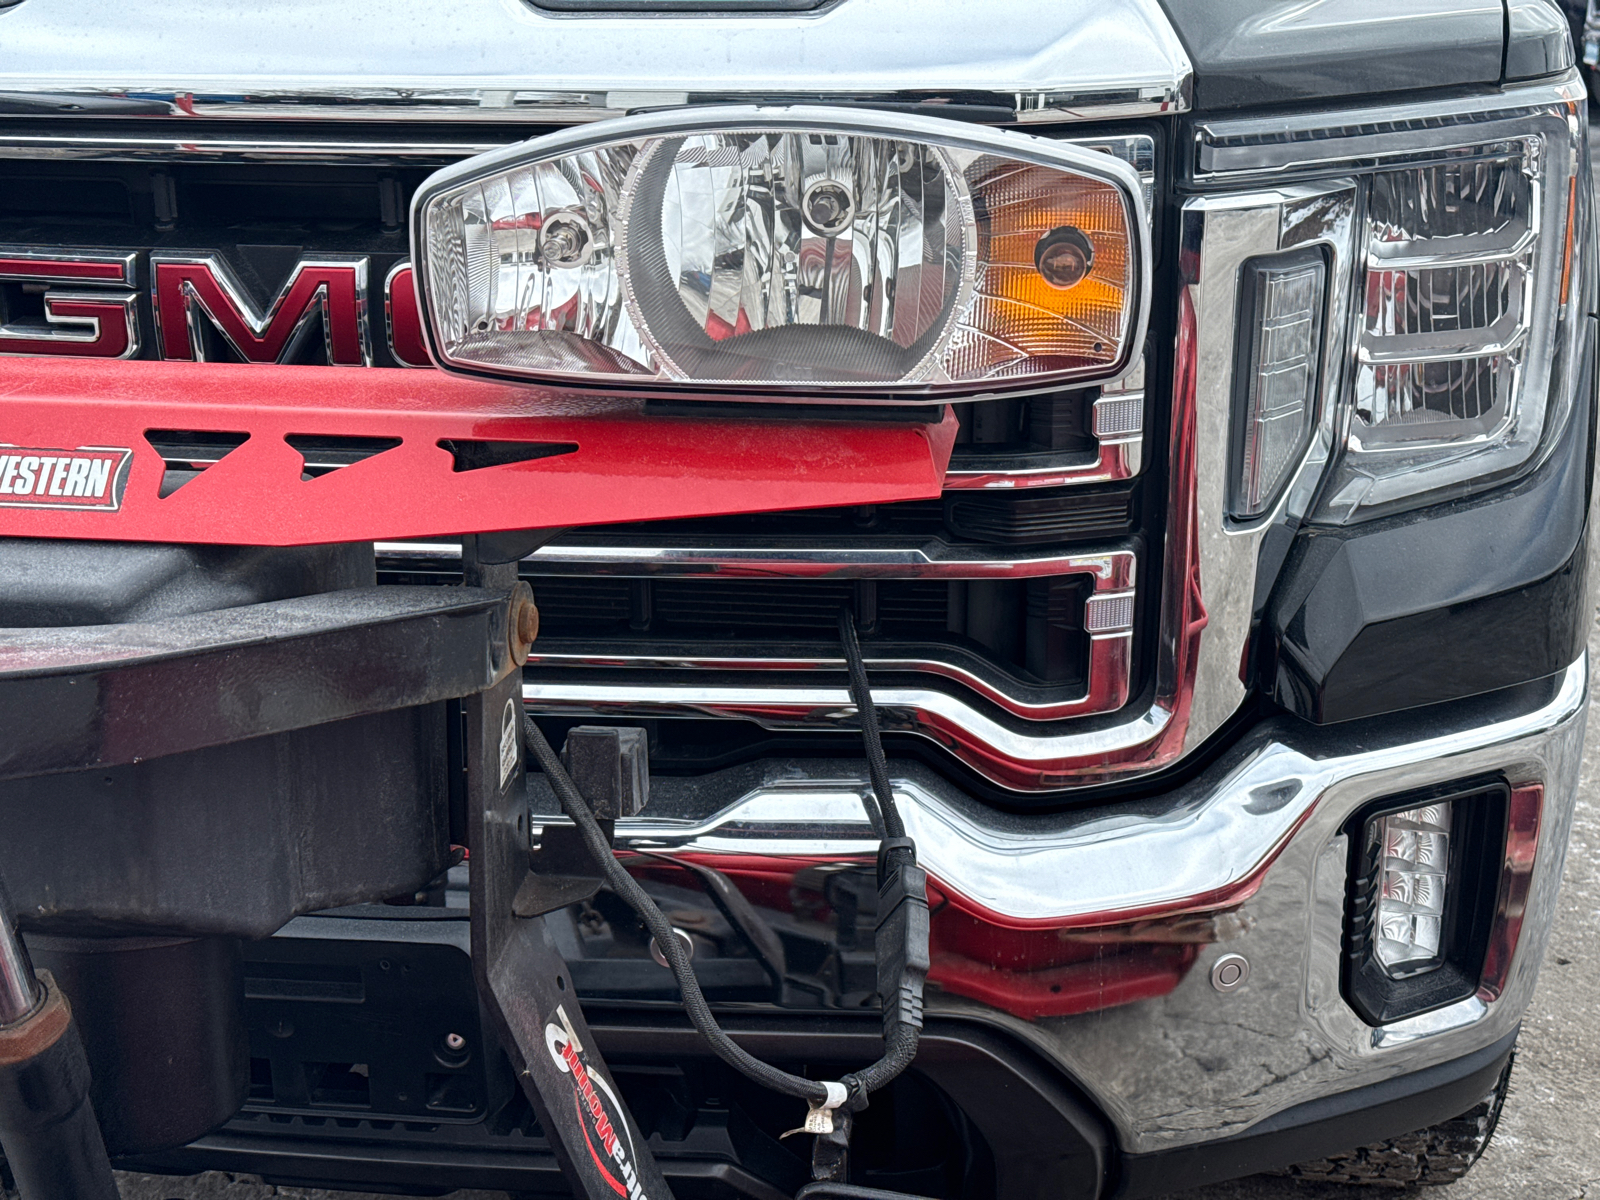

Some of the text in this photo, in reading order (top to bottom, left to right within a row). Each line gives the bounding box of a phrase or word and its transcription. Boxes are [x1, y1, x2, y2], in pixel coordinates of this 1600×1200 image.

[0, 251, 434, 367] GM
[0, 455, 112, 497] ESTERN
[562, 1040, 649, 1200] ltraMount
